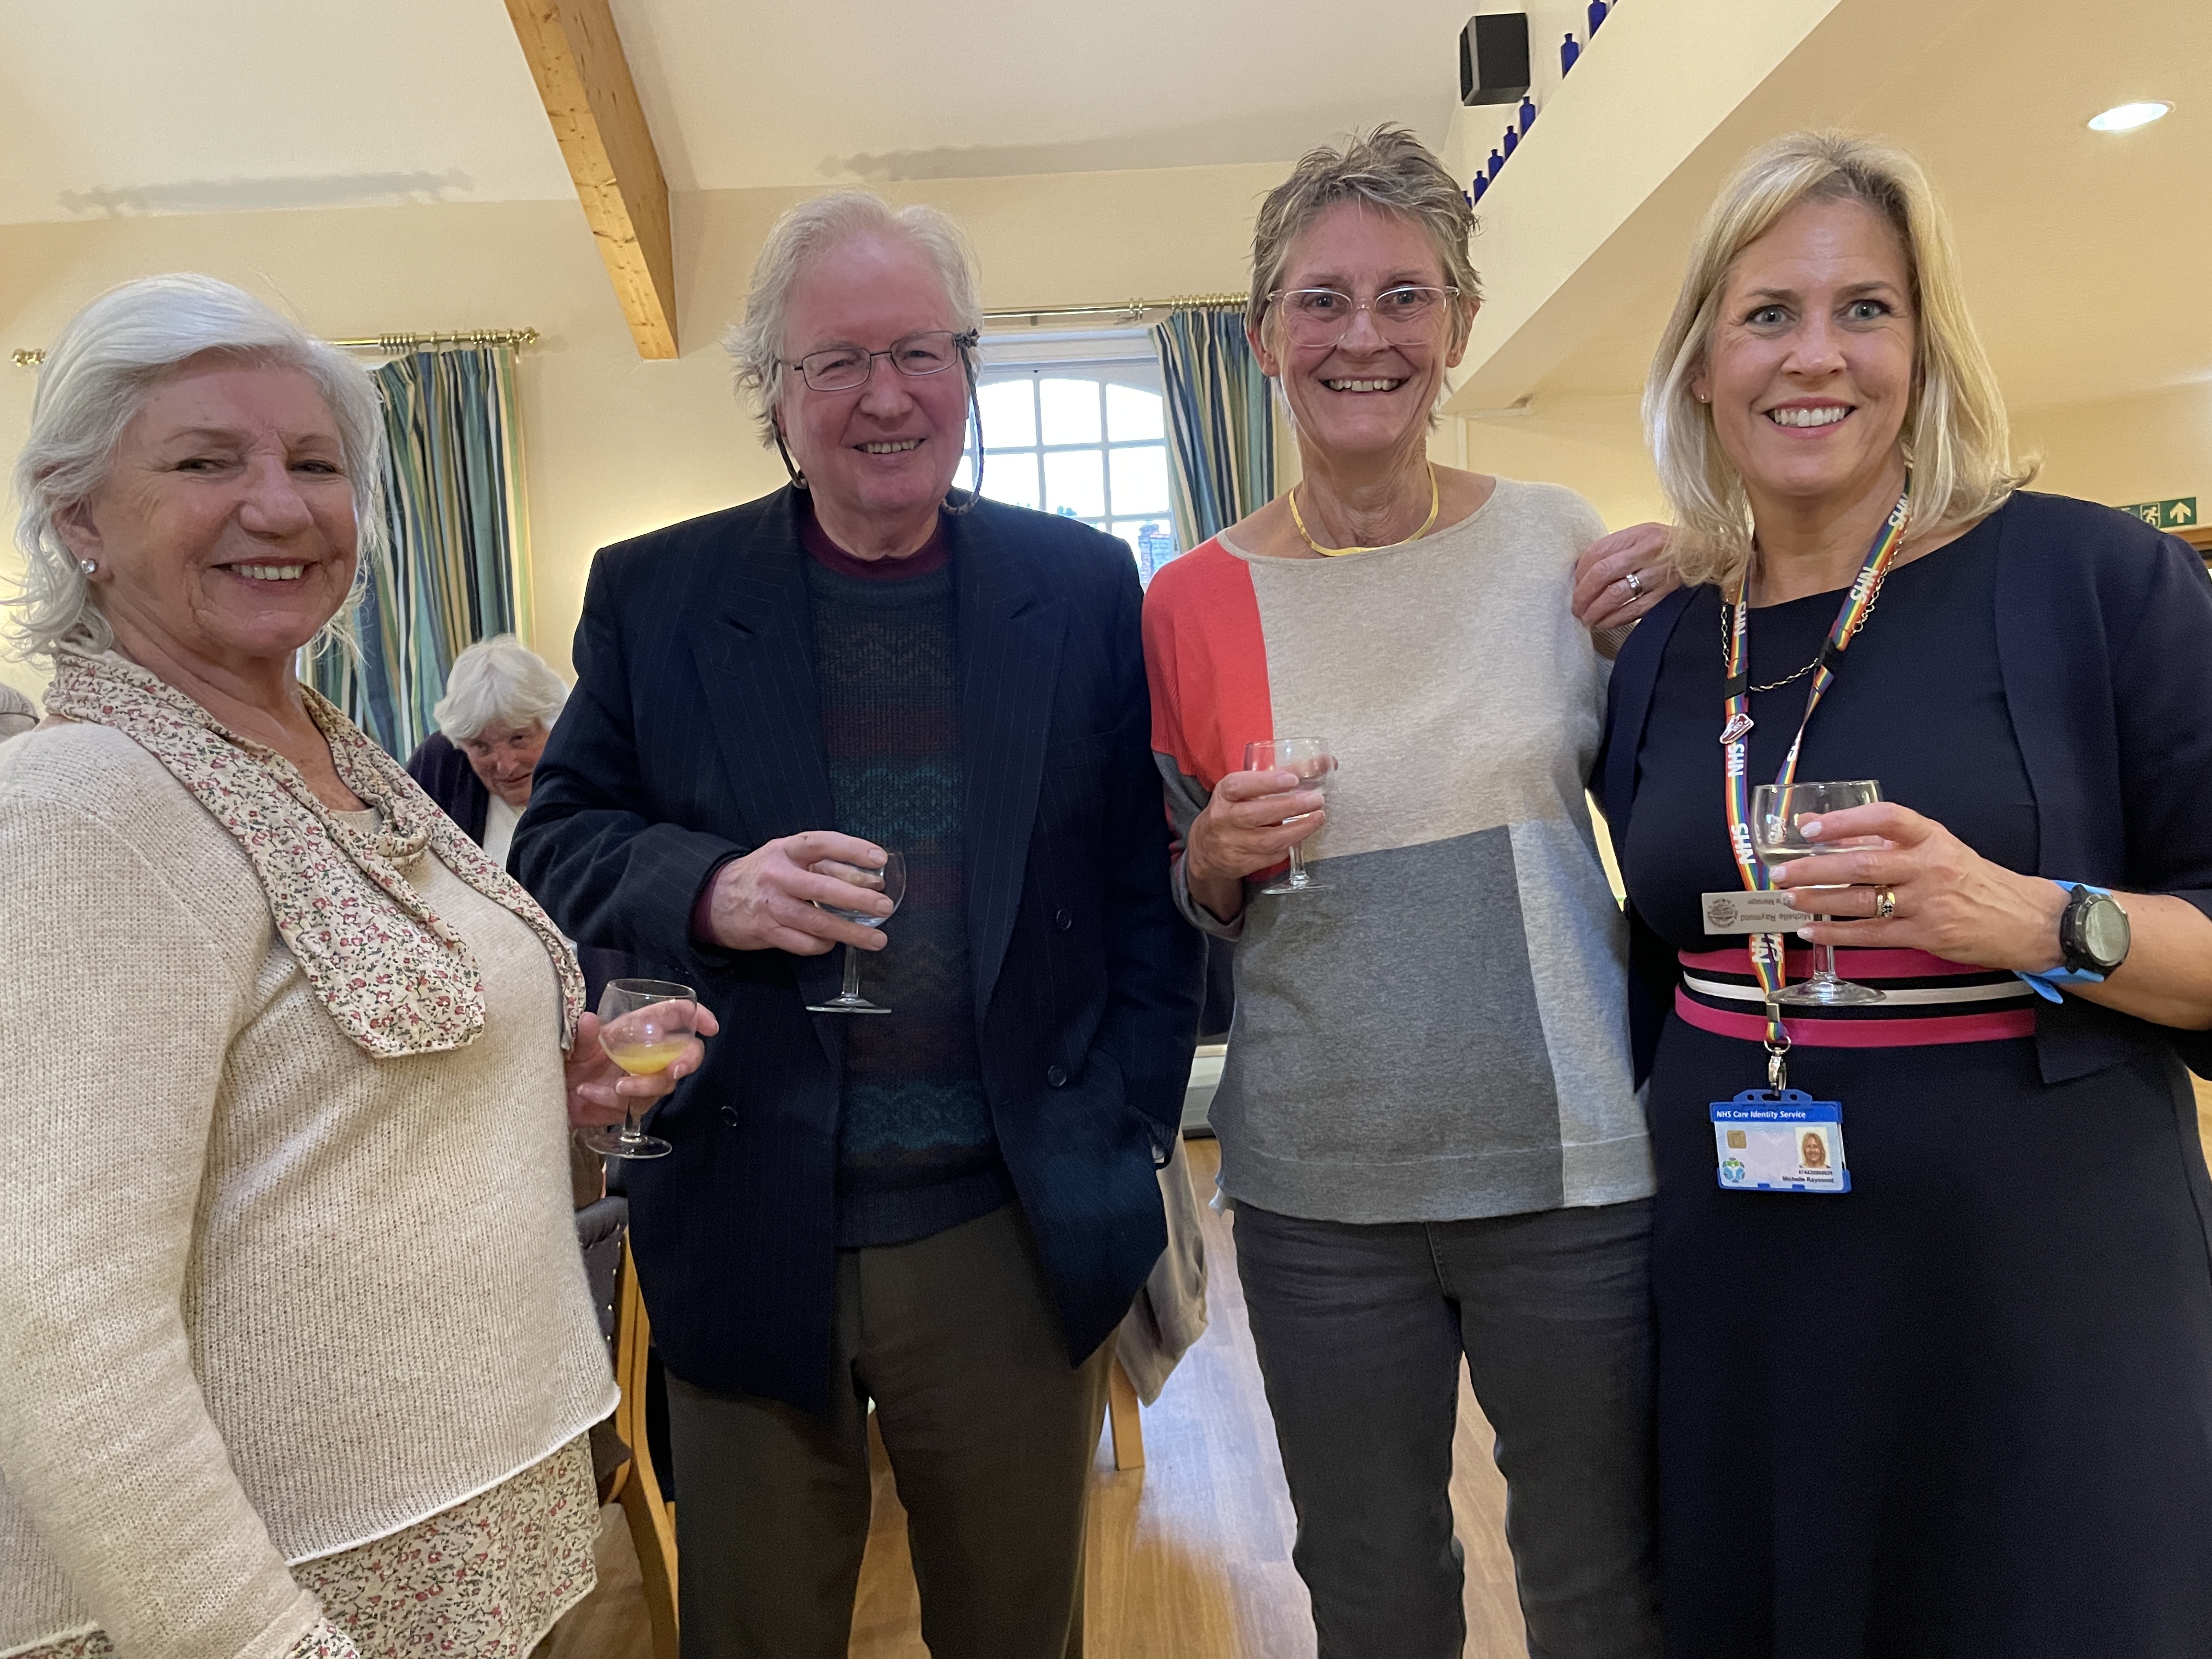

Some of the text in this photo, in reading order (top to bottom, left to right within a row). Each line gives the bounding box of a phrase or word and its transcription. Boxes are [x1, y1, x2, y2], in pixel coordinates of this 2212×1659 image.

[1849, 567, 1878, 604] NHS
[1734, 601, 1747, 636] NHS
[1728, 743, 1745, 778] NHS
[1731, 823, 1756, 865] NHS
[1740, 913, 1811, 921] Michelle Raymond
[1751, 933, 1771, 963] NH
[1751, 1110, 1778, 1119] Identity
